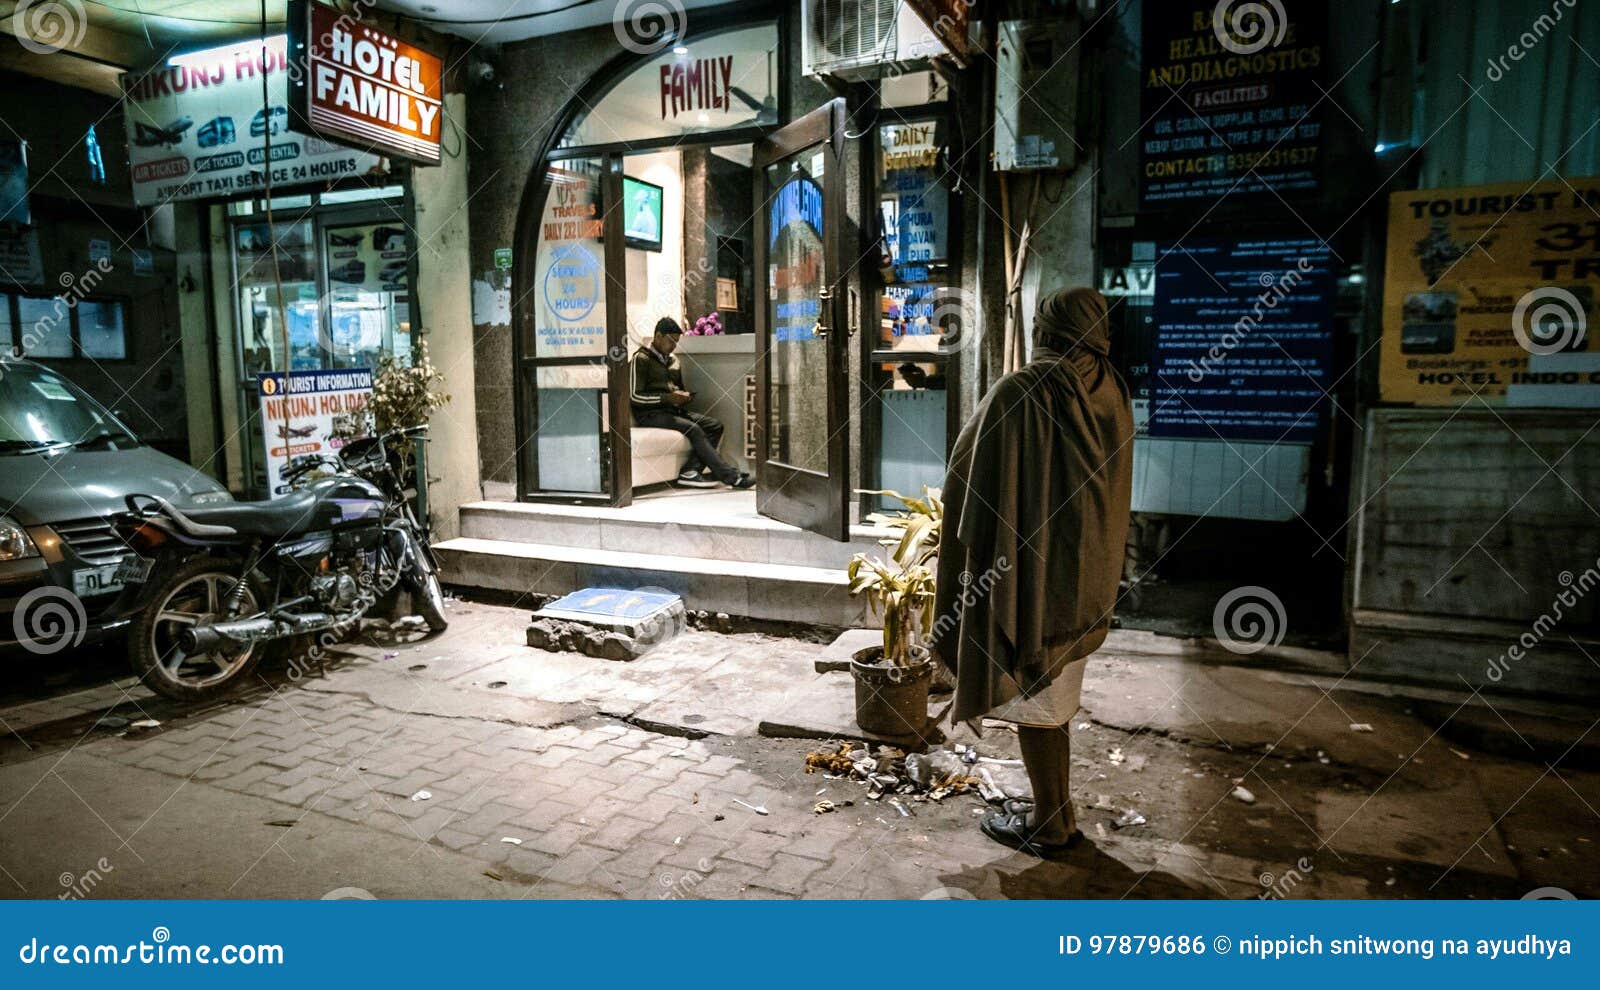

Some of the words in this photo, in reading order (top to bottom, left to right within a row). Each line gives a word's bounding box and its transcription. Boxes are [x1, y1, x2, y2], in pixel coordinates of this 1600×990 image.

[332, 27, 425, 95] HOTEL
[1146, 64, 1186, 88] AND
[1190, 45, 1321, 82] DIAGNOSTICS
[124, 64, 225, 104] NIKUNJ
[660, 55, 733, 121] FAMILY
[1194, 84, 1269, 108] FACILITIES
[317, 63, 438, 136] FAMILY
[893, 126, 930, 147] DAILY
[151, 160, 188, 178] TICKETS
[213, 154, 243, 168] TICKETS
[157, 181, 206, 198] AIRPORT
[207, 176, 233, 191] TAXI
[237, 168, 288, 188] SERVCE
[292, 166, 307, 179] 24
[310, 158, 357, 176] HOURS
[553, 203, 597, 218] TRAVELS
[1408, 191, 1561, 219] TOURIST
[553, 265, 590, 278] SERVICE
[555, 298, 591, 309] HOURS
[277, 376, 315, 393] TOURIST
[317, 372, 372, 391] INFORMATION
[1418, 372, 1502, 385] HOTEL
[1512, 371, 1580, 384] INDO
[267, 396, 316, 420] NIKUNJ
